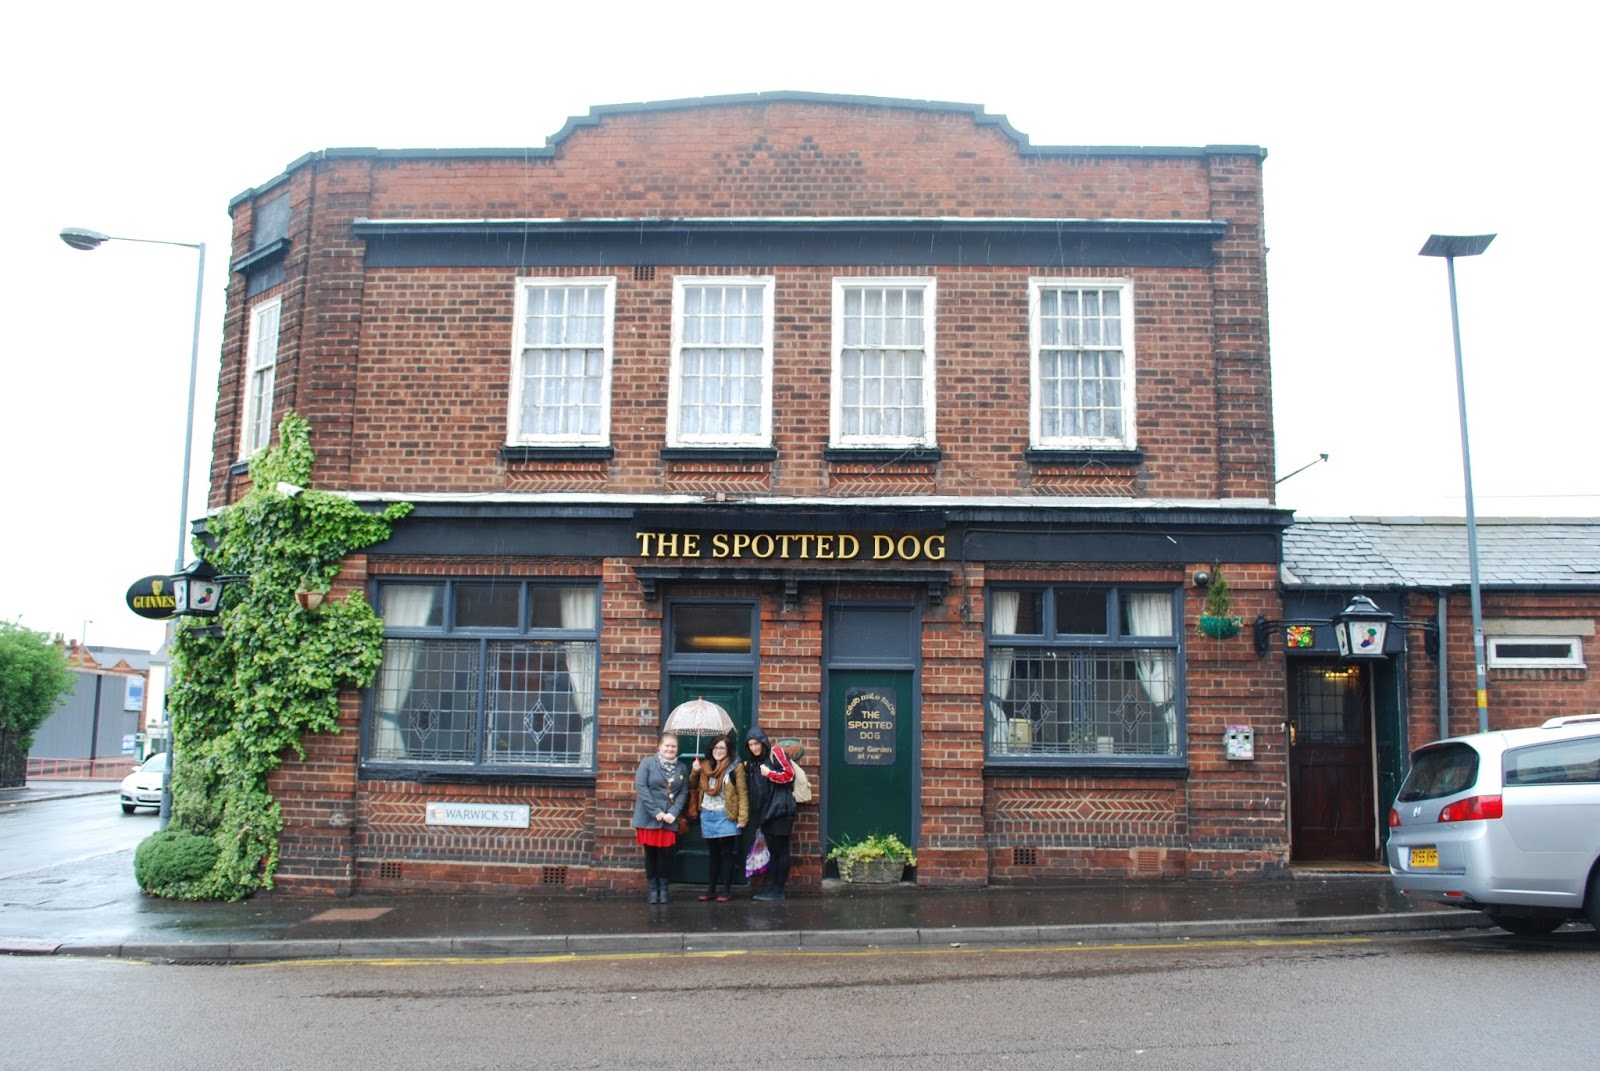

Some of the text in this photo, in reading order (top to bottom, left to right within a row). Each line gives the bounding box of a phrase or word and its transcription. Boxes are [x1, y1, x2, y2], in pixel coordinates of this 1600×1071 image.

[635, 532, 946, 561] THE SPOTTED DOG
[133, 595, 176, 608] GUINNES
[861, 710, 880, 719] THE
[848, 721, 893, 730] SPOTTED
[860, 732, 880, 740] DOG
[867, 744, 892, 753] Garden
[445, 809, 499, 821] WARWICK
